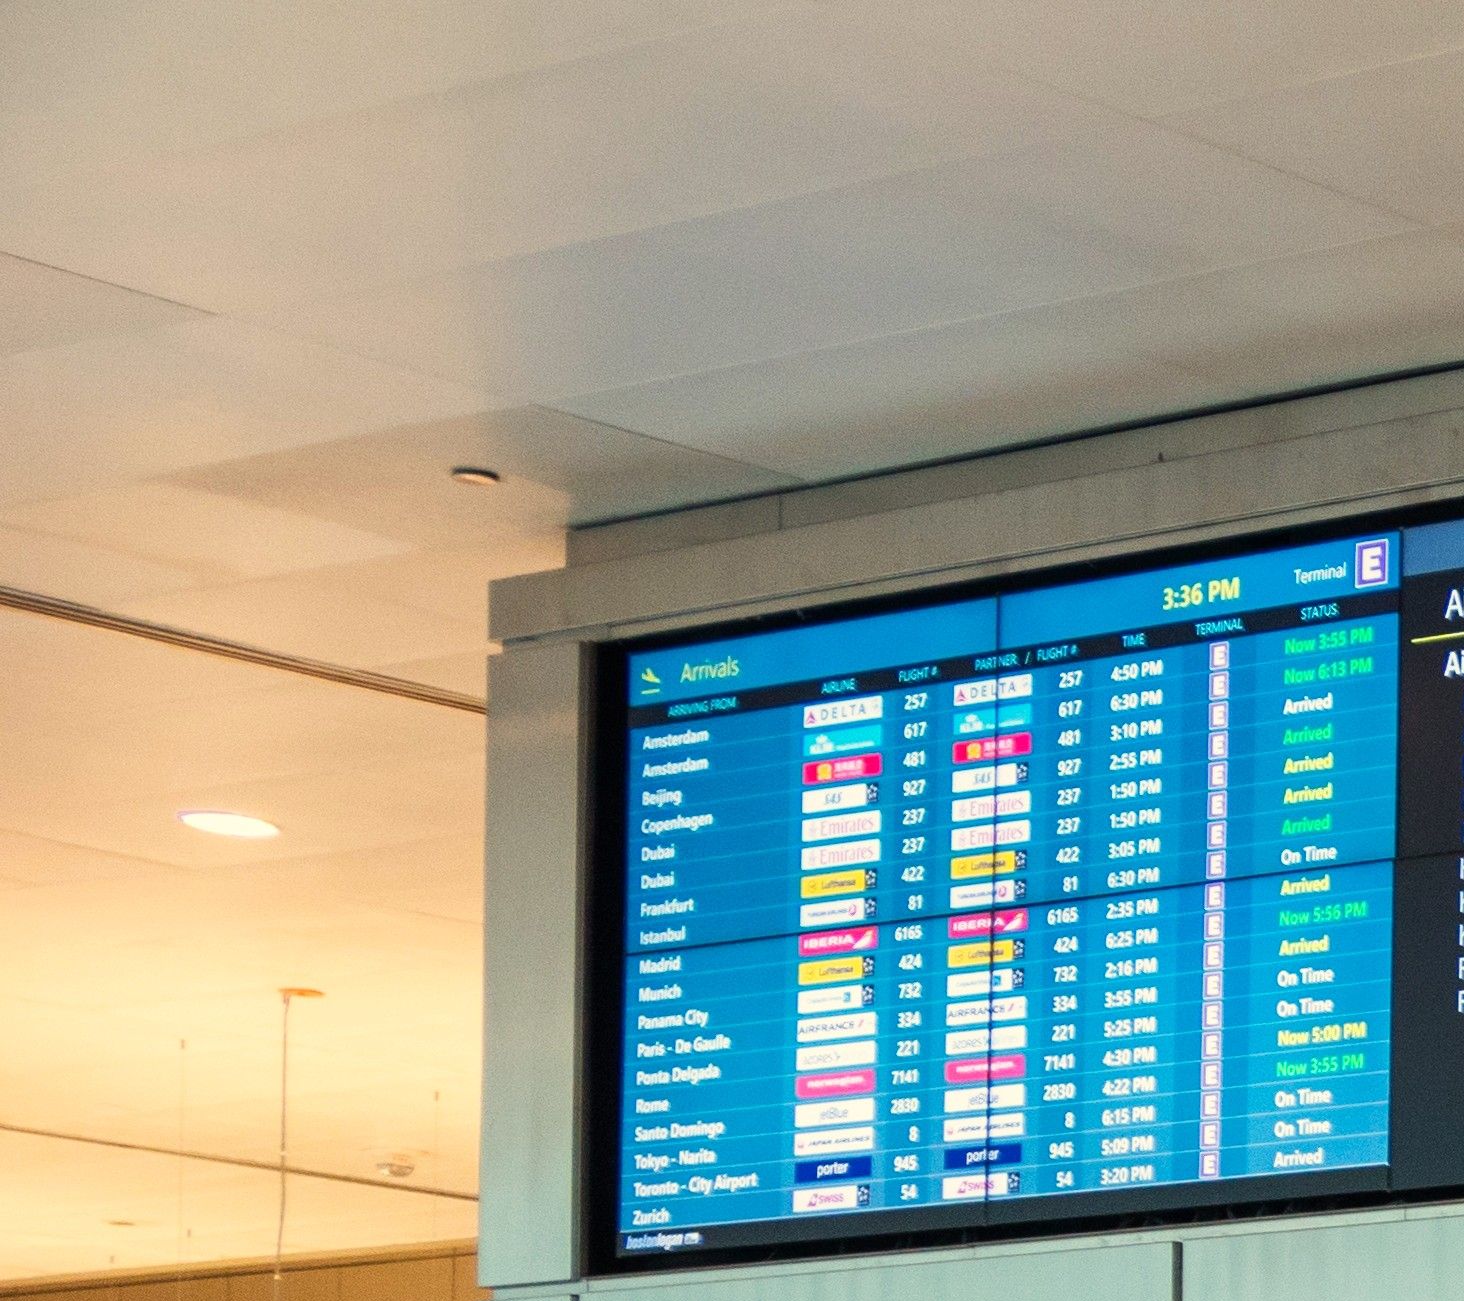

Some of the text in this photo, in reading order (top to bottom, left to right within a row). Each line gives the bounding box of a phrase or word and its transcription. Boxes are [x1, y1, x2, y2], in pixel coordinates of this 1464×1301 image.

[1294, 546, 1382, 584] Terminal E
[1162, 577, 1240, 610] 3:36 PM
[1300, 603, 1339, 620] STATUS
[1196, 619, 1245, 636] TERMINAL
[1122, 633, 1145, 647] TIME
[1285, 626, 1373, 655] Now 3:55 PM
[975, 654, 1018, 670] PARTNER
[1037, 648, 1068, 661] FLIGHT
[680, 656, 739, 683] Arrivals
[899, 670, 928, 682] FLIGHT
[1059, 670, 1083, 689] 257
[1111, 660, 1163, 681] 4:50 PM
[1284, 657, 1373, 685] Now 6:13 PM
[821, 679, 857, 693] AIRLINE
[668, 696, 738, 718] ARRIVING FROM
[904, 692, 928, 711] 257
[1110, 689, 1163, 712] 6:30 PM
[1283, 692, 1333, 715] Arrived
[821, 703, 867, 721] DELTA
[642, 729, 710, 750] Amsterdam
[904, 722, 927, 740] 617
[1110, 719, 1163, 741] 3:10 PM
[1283, 724, 1332, 745] Arrived
[642, 757, 709, 778] Amsterdam
[642, 788, 682, 807] Beijing
[641, 813, 713, 834] Copenhagen
[820, 817, 874, 837] Emirates
[641, 844, 675, 861] Dubai
[1281, 846, 1338, 865] On Time
[640, 871, 675, 889] Dubai
[821, 876, 857, 890] Lufthansa
[640, 898, 694, 918] Frankfurt
[1106, 898, 1159, 920] 2:35 PM
[1279, 902, 1367, 926] Now 5:56 PM
[639, 926, 686, 945] Istanbul
[803, 933, 855, 950] IBERIA
[895, 925, 923, 942] 6165
[639, 955, 682, 974] Madrid
[638, 984, 682, 1002] Munich
[637, 1009, 709, 1030] Panama City
[1278, 1021, 1366, 1046] Now 5:00 PM
[637, 1033, 732, 1058] Paris De Gaulle
[636, 1063, 721, 1086] Ponta Delgada
[635, 1098, 670, 1114] Rome
[634, 1121, 726, 1143] Santo Domingo
[1049, 1142, 1074, 1159] 945
[1101, 1135, 1154, 1156] 5:09 PM
[634, 1148, 717, 1173] Tokyo Narita
[1273, 1147, 1324, 1168] Arrived
[816, 1161, 849, 1178] porter
[1056, 1171, 1074, 1188] 54
[634, 1173, 759, 1198] Toronto City Airport
[819, 1192, 844, 1205] SWISS
[633, 1207, 671, 1225] Zurich
